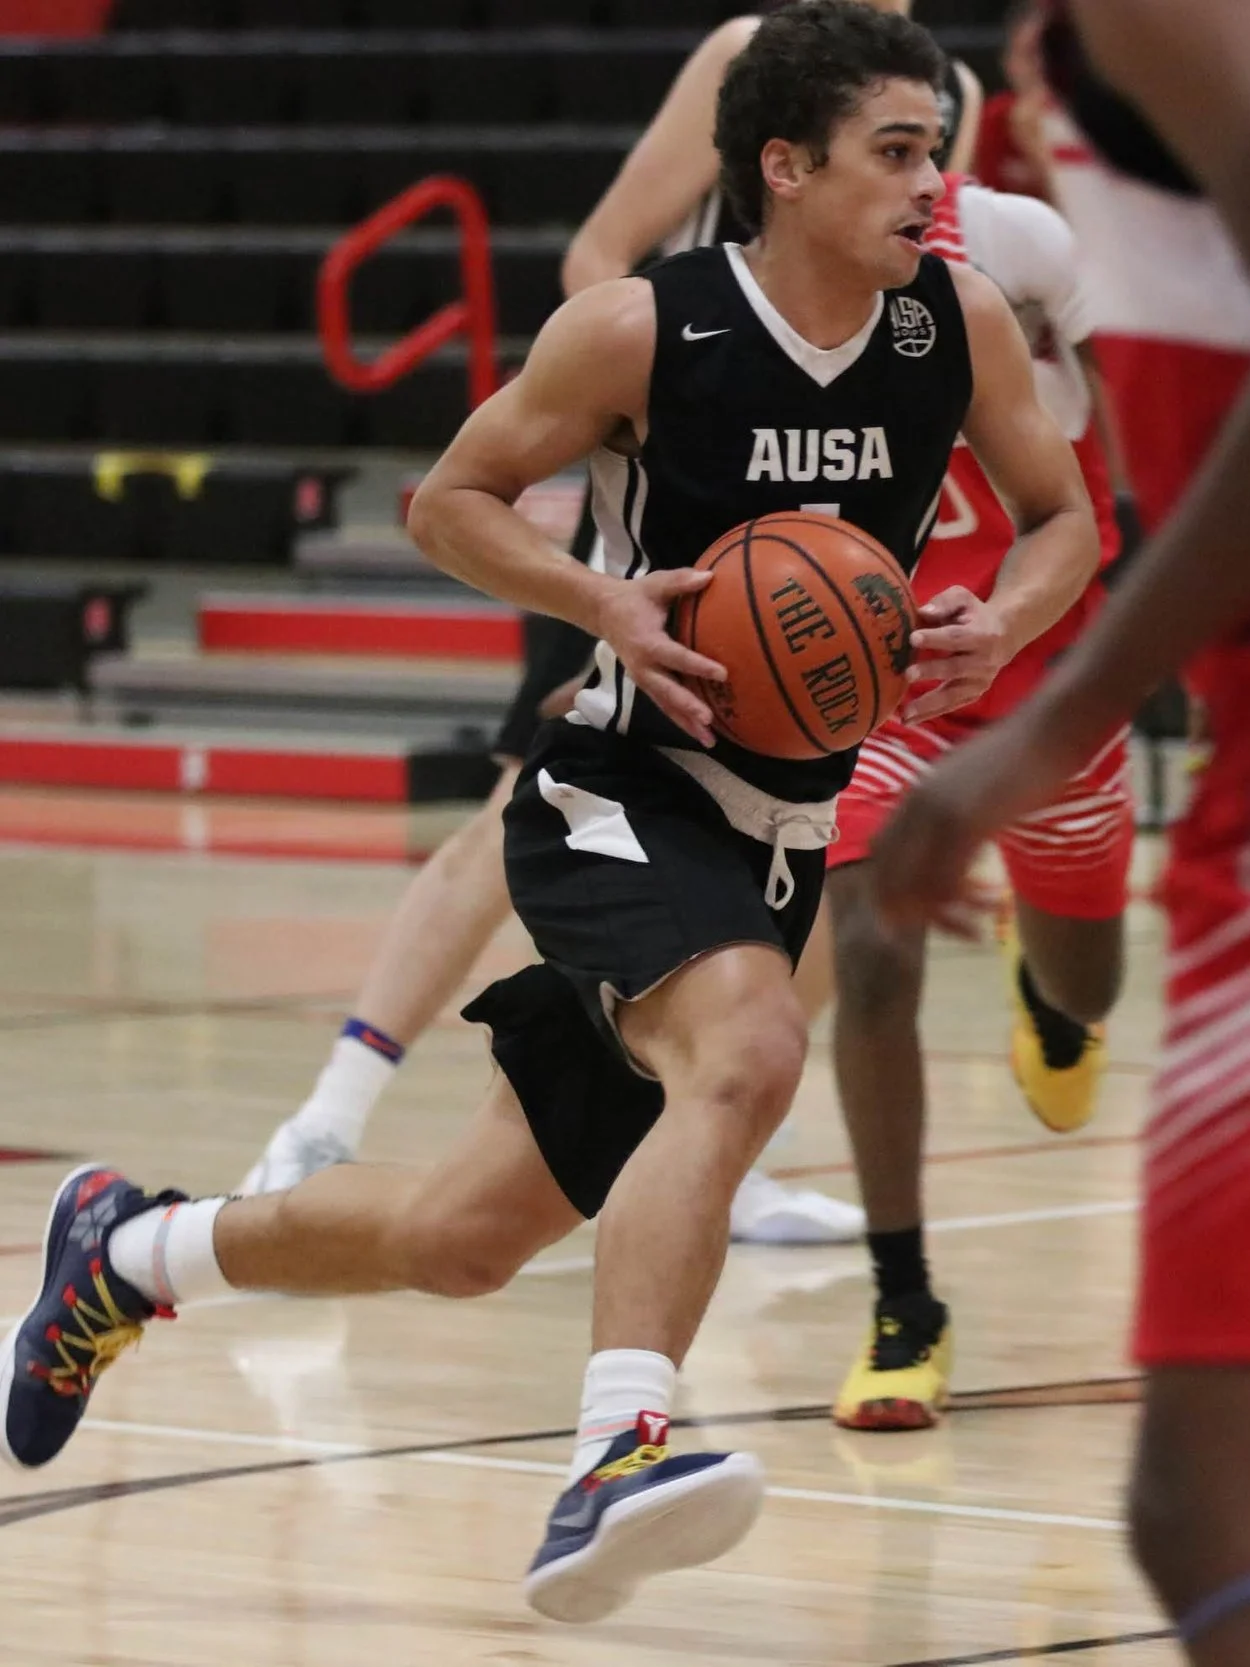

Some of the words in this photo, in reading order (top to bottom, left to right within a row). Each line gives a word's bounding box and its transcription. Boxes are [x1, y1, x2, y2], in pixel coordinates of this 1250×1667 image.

[745, 427, 893, 482] AUSA
[770, 577, 836, 654] THE
[801, 653, 861, 734] ROCK
